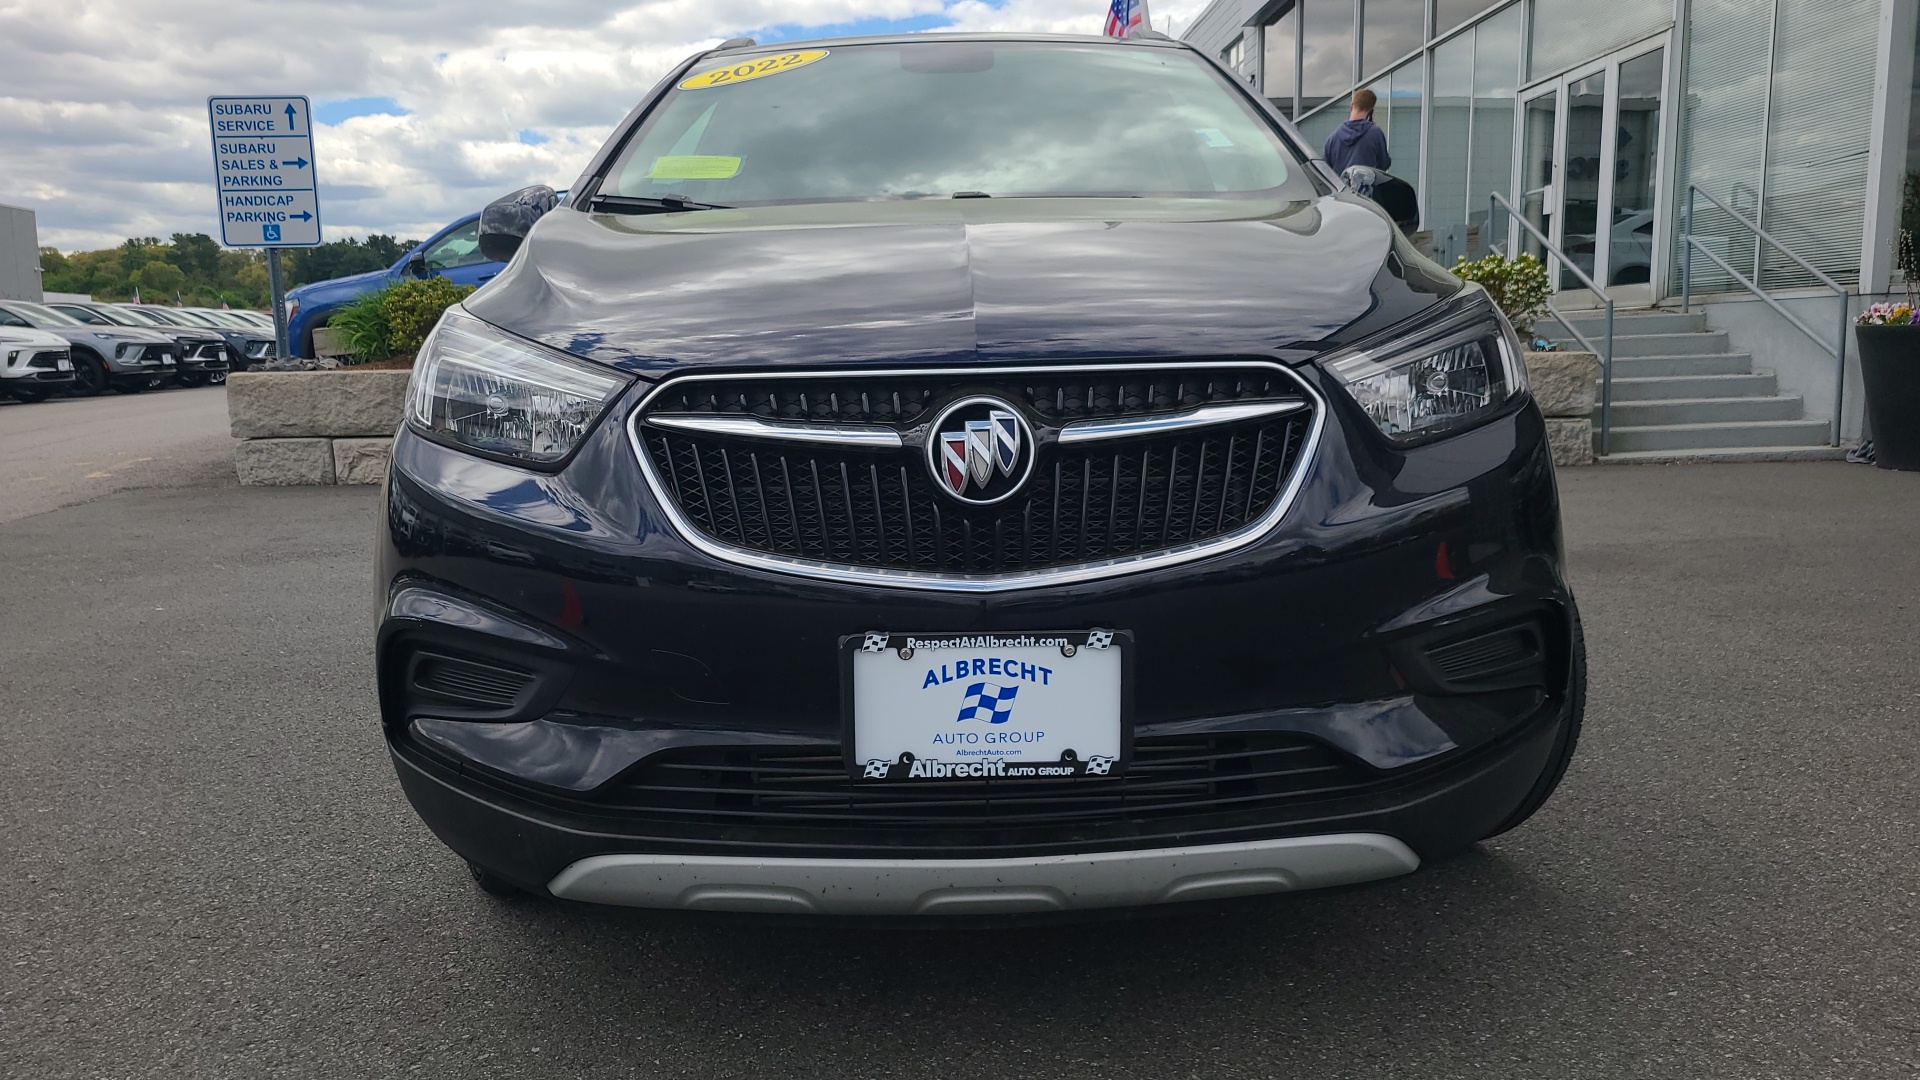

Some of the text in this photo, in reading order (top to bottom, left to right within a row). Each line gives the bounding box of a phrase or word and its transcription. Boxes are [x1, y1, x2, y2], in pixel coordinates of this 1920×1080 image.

[709, 54, 802, 84] 2022
[216, 104, 272, 115] SUBARU
[218, 120, 275, 132] SERVICE
[220, 143, 276, 154] SUBARU
[222, 160, 278, 170] SALES &
[224, 176, 282, 186] PARKING
[226, 196, 294, 206] HANDICAP
[228, 212, 286, 222] PARKING
[906, 636, 1068, 651] RespectAtAlbrecht.com
[922, 658, 1053, 689] ALBRECHT
[933, 732, 1045, 744] AUTO GROUP
[909, 758, 1074, 778] Albrecht AUTO GROUP
